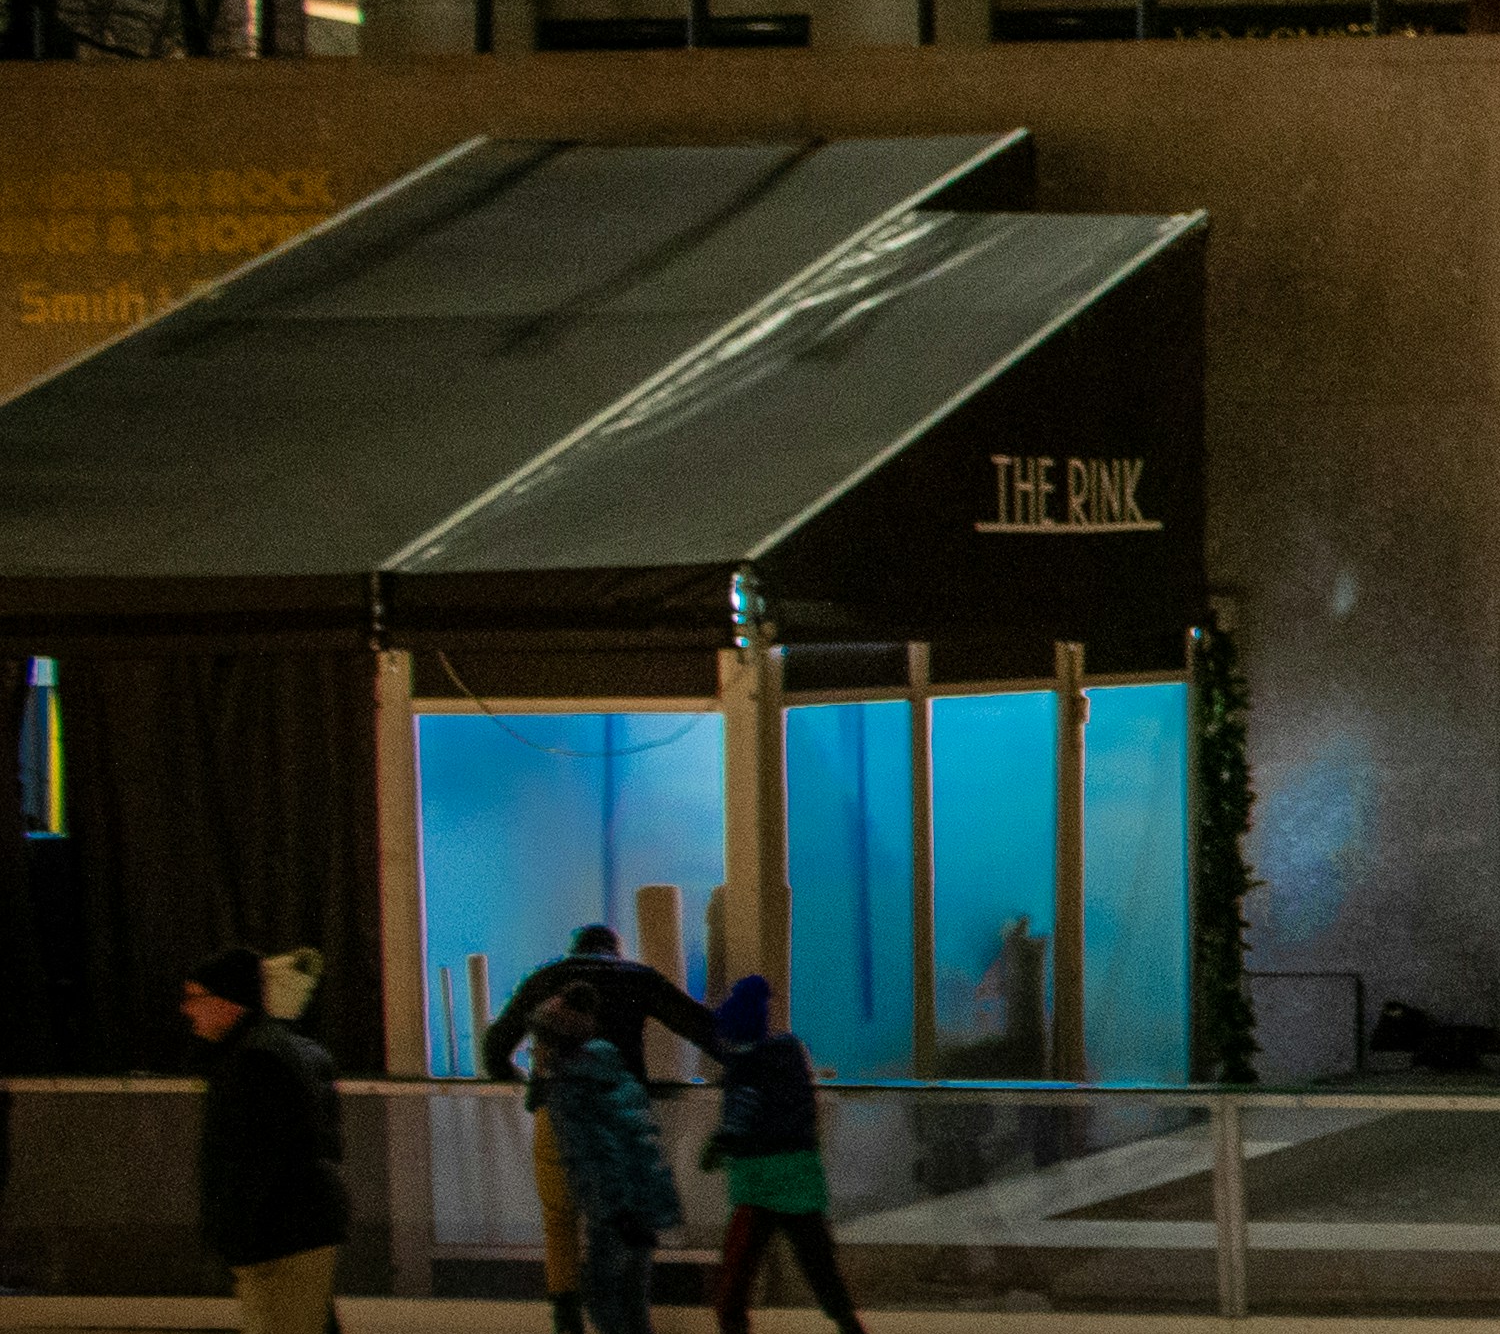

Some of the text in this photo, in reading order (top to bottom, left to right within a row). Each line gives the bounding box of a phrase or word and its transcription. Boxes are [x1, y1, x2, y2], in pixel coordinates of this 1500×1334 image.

[208, 168, 336, 209] ROCK
[990, 453, 1144, 525] THE RINK
